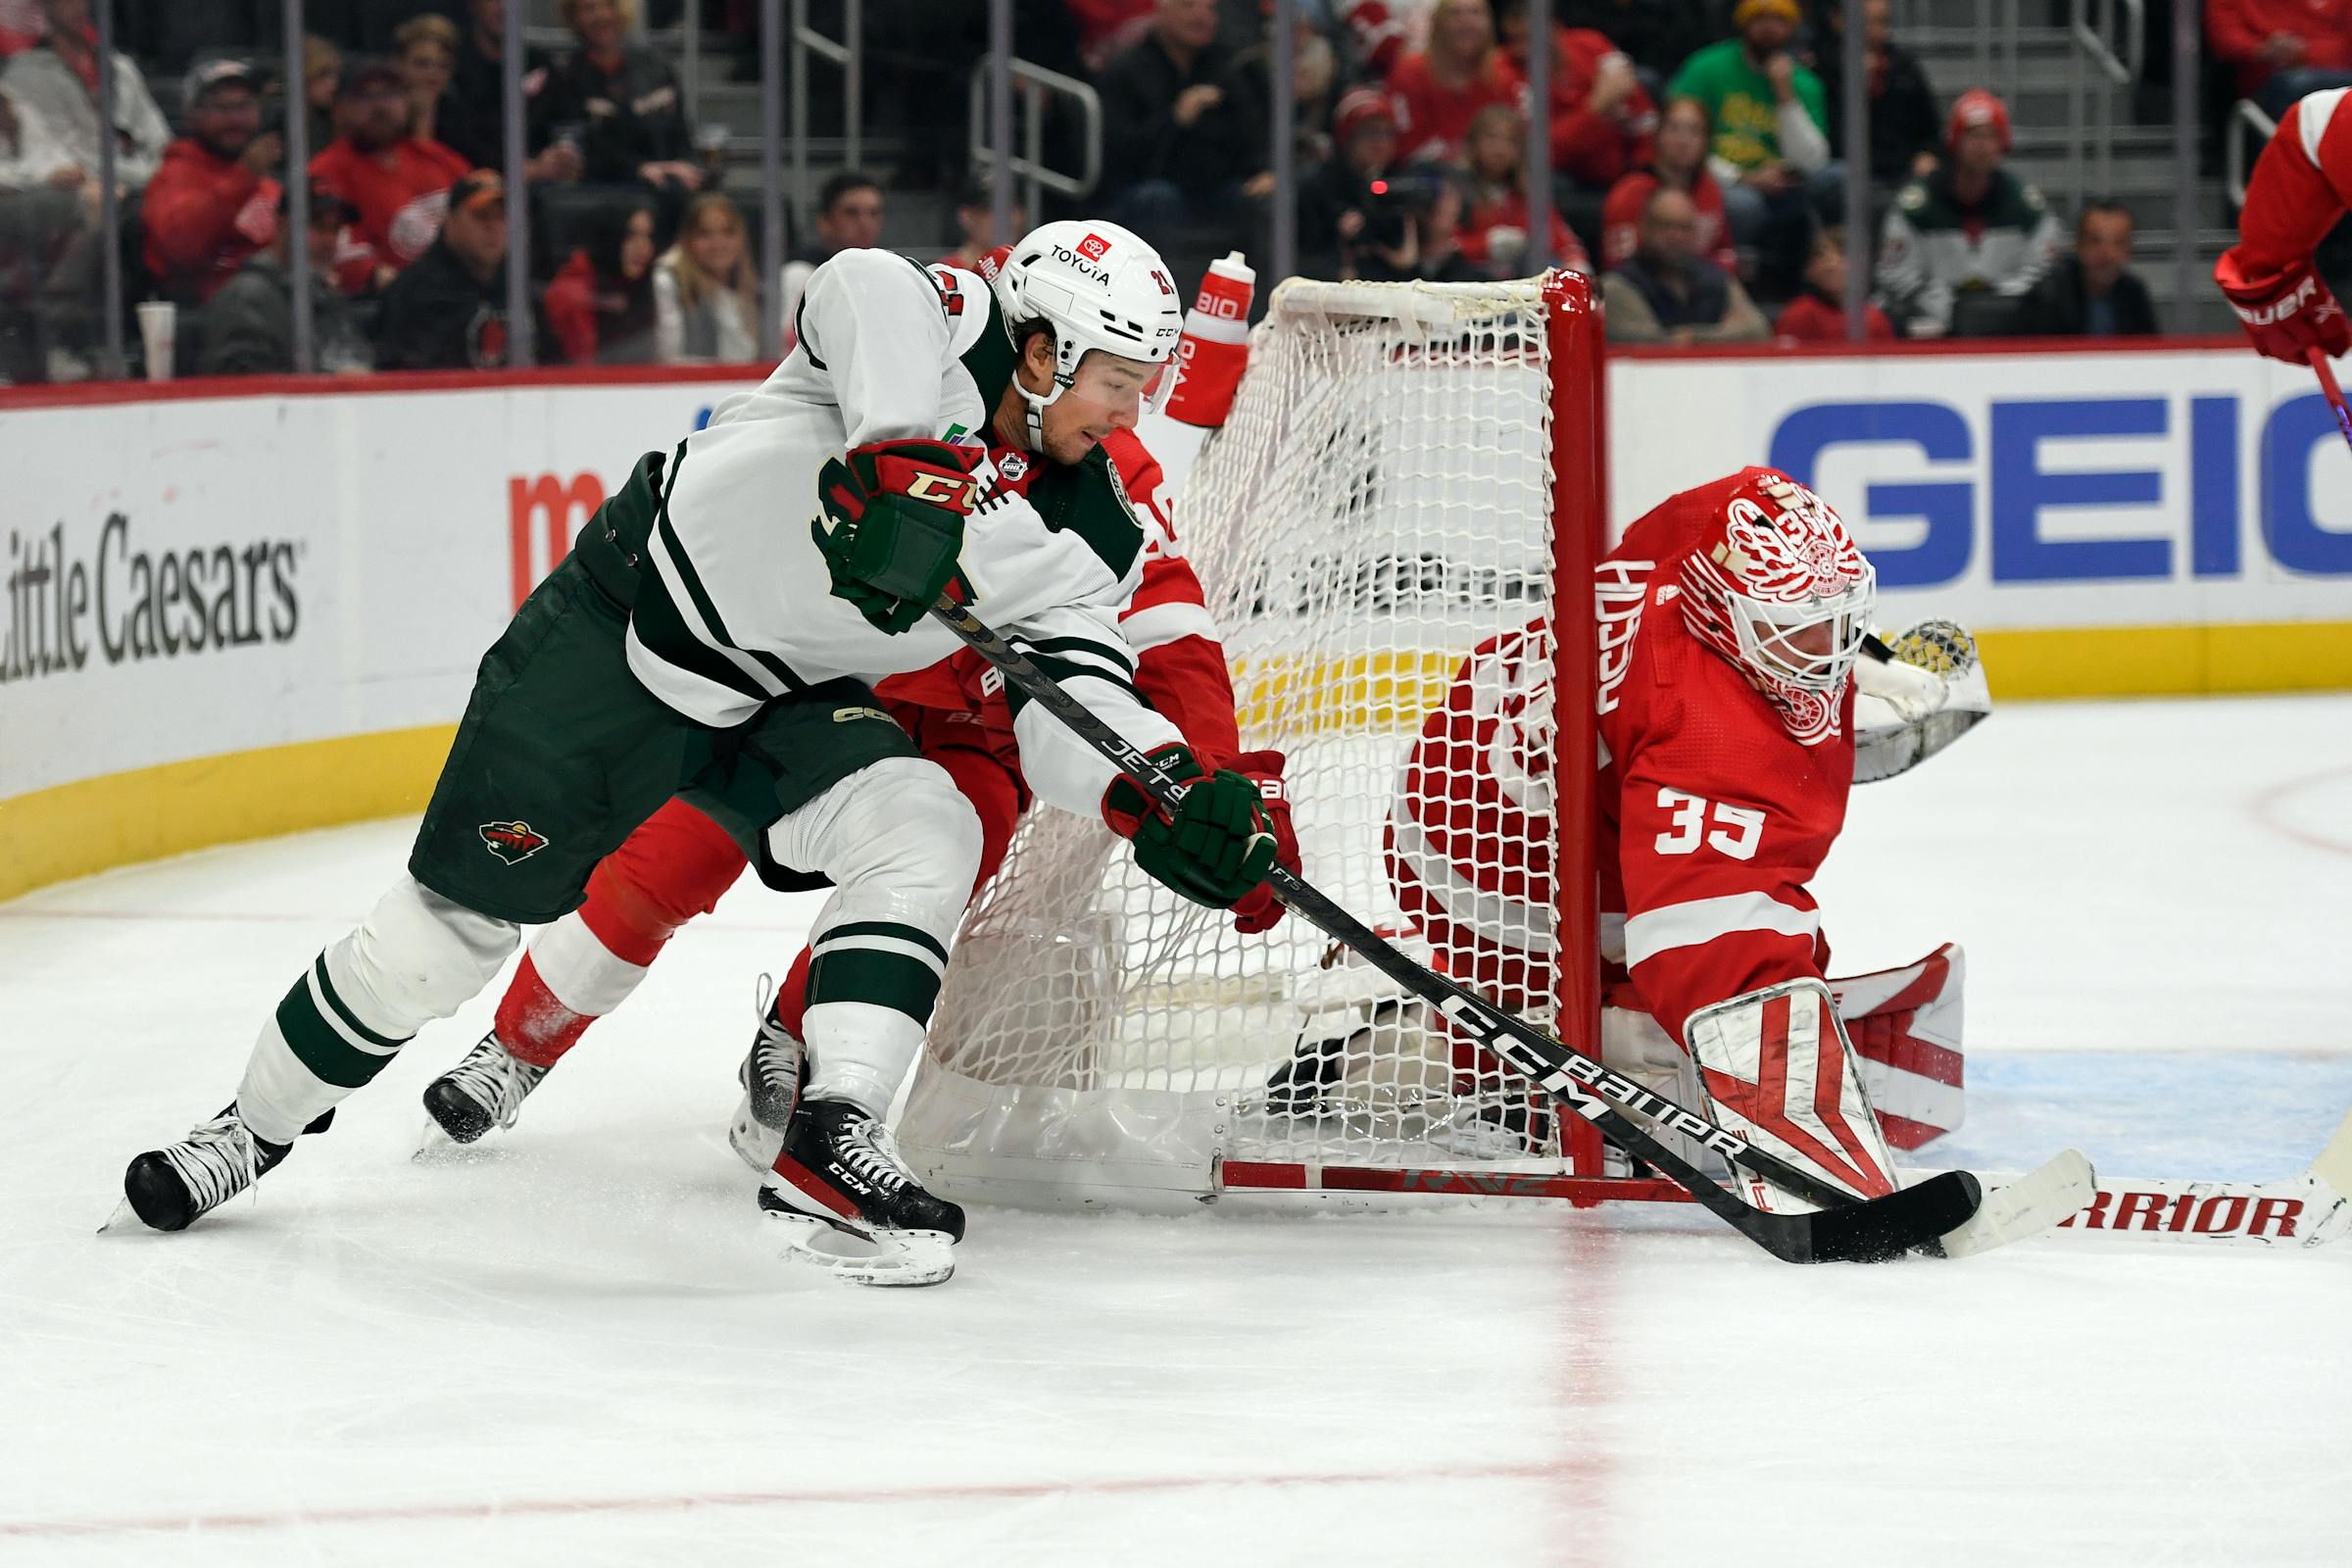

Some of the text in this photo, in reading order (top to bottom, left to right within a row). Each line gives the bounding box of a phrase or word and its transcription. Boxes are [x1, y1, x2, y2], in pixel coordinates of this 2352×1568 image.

[1052, 244, 1109, 287] TOYOTA
[1196, 290, 1239, 320] BIO
[1054, 374, 1075, 385] CCM
[0, 512, 299, 683] ittle Caesars
[1654, 786, 1767, 861] 35
[1440, 994, 1611, 1121] CCM
[828, 1160, 872, 1196] CCM
